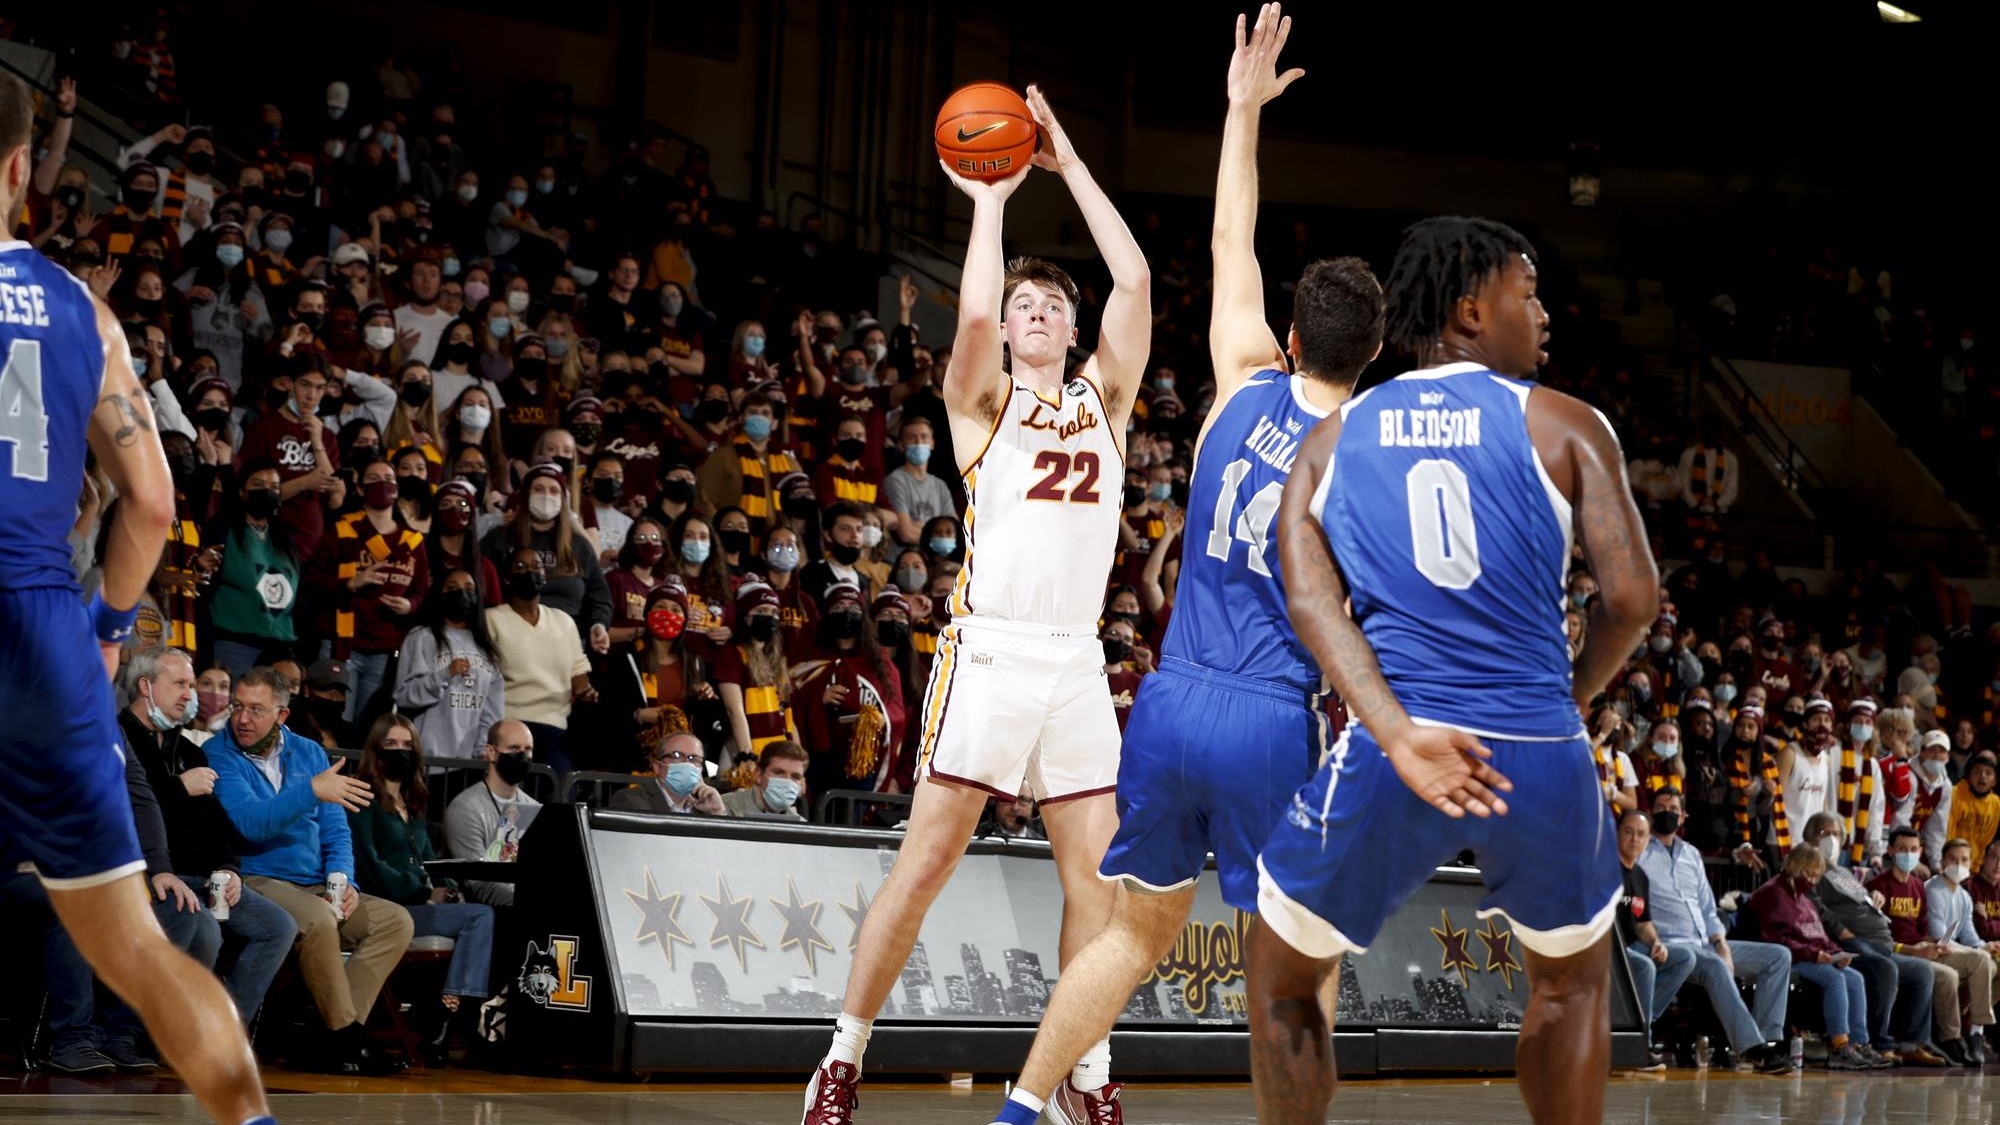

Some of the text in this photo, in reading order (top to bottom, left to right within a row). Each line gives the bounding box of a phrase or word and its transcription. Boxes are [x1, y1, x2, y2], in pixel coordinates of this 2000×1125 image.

[0, 282, 50, 327] ESE
[0, 338, 49, 482] 4
[1379, 408, 1481, 448] BLEDSON
[1024, 450, 1100, 505] 22
[1206, 458, 1284, 578] 14
[1406, 458, 1483, 590] 0
